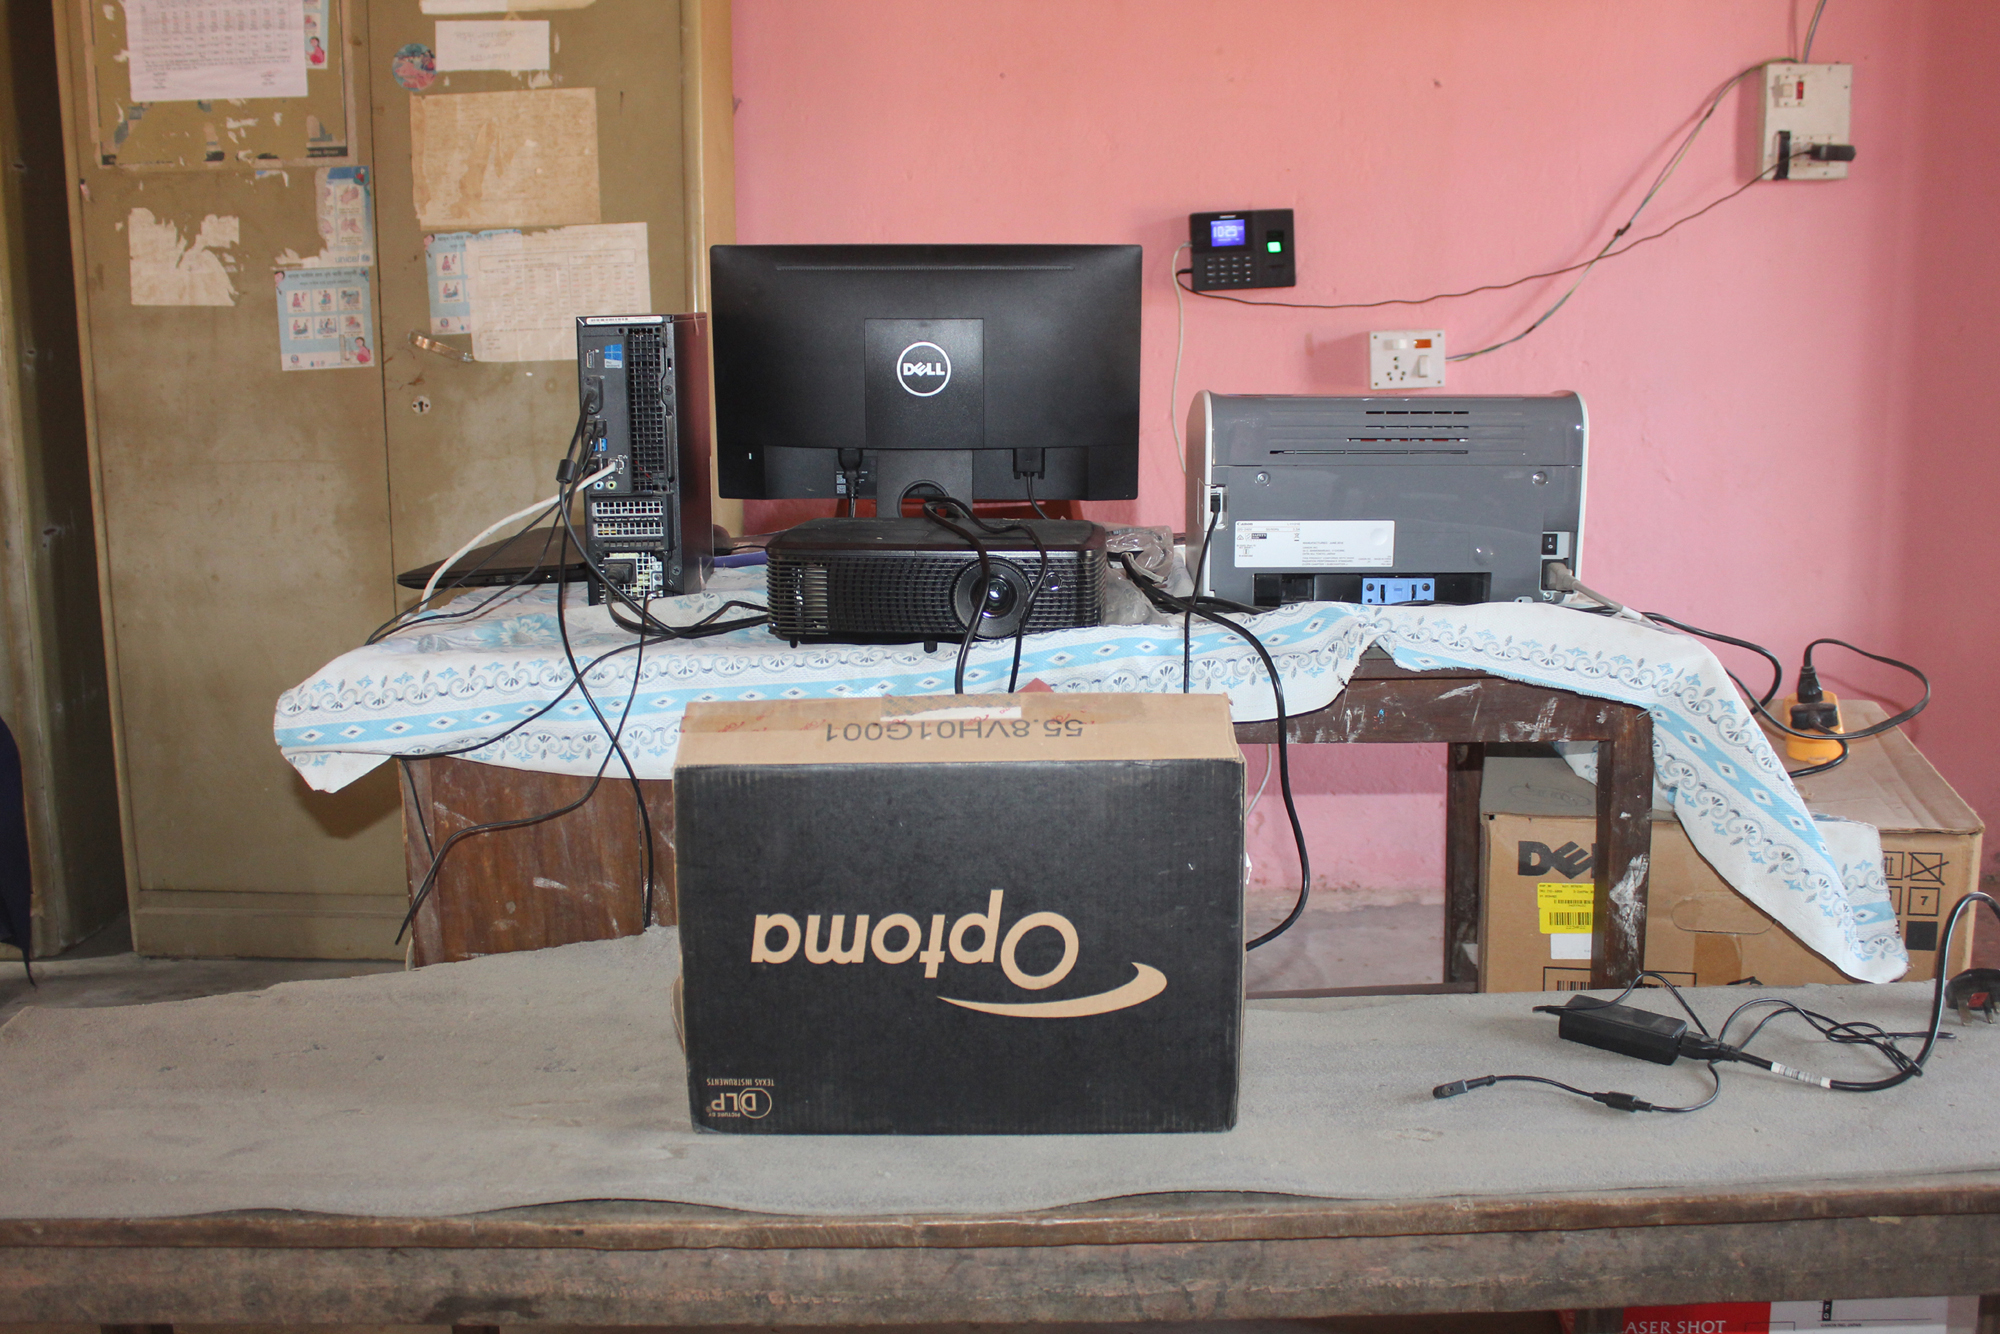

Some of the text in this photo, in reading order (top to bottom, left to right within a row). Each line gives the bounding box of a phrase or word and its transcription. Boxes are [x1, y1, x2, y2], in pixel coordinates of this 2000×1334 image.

[902, 361, 946, 377] DELL
[825, 717, 1084, 743] 55.8VH01G001
[1517, 840, 1597, 880] DE
[1920, 896, 1929, 906] 7
[750, 889, 1080, 990] Optoma
[706, 1078, 775, 1087] TEXAS INSTRUMENTS
[710, 1092, 757, 1112] DLP
[1676, 1319, 1727, 1334] SHOT
